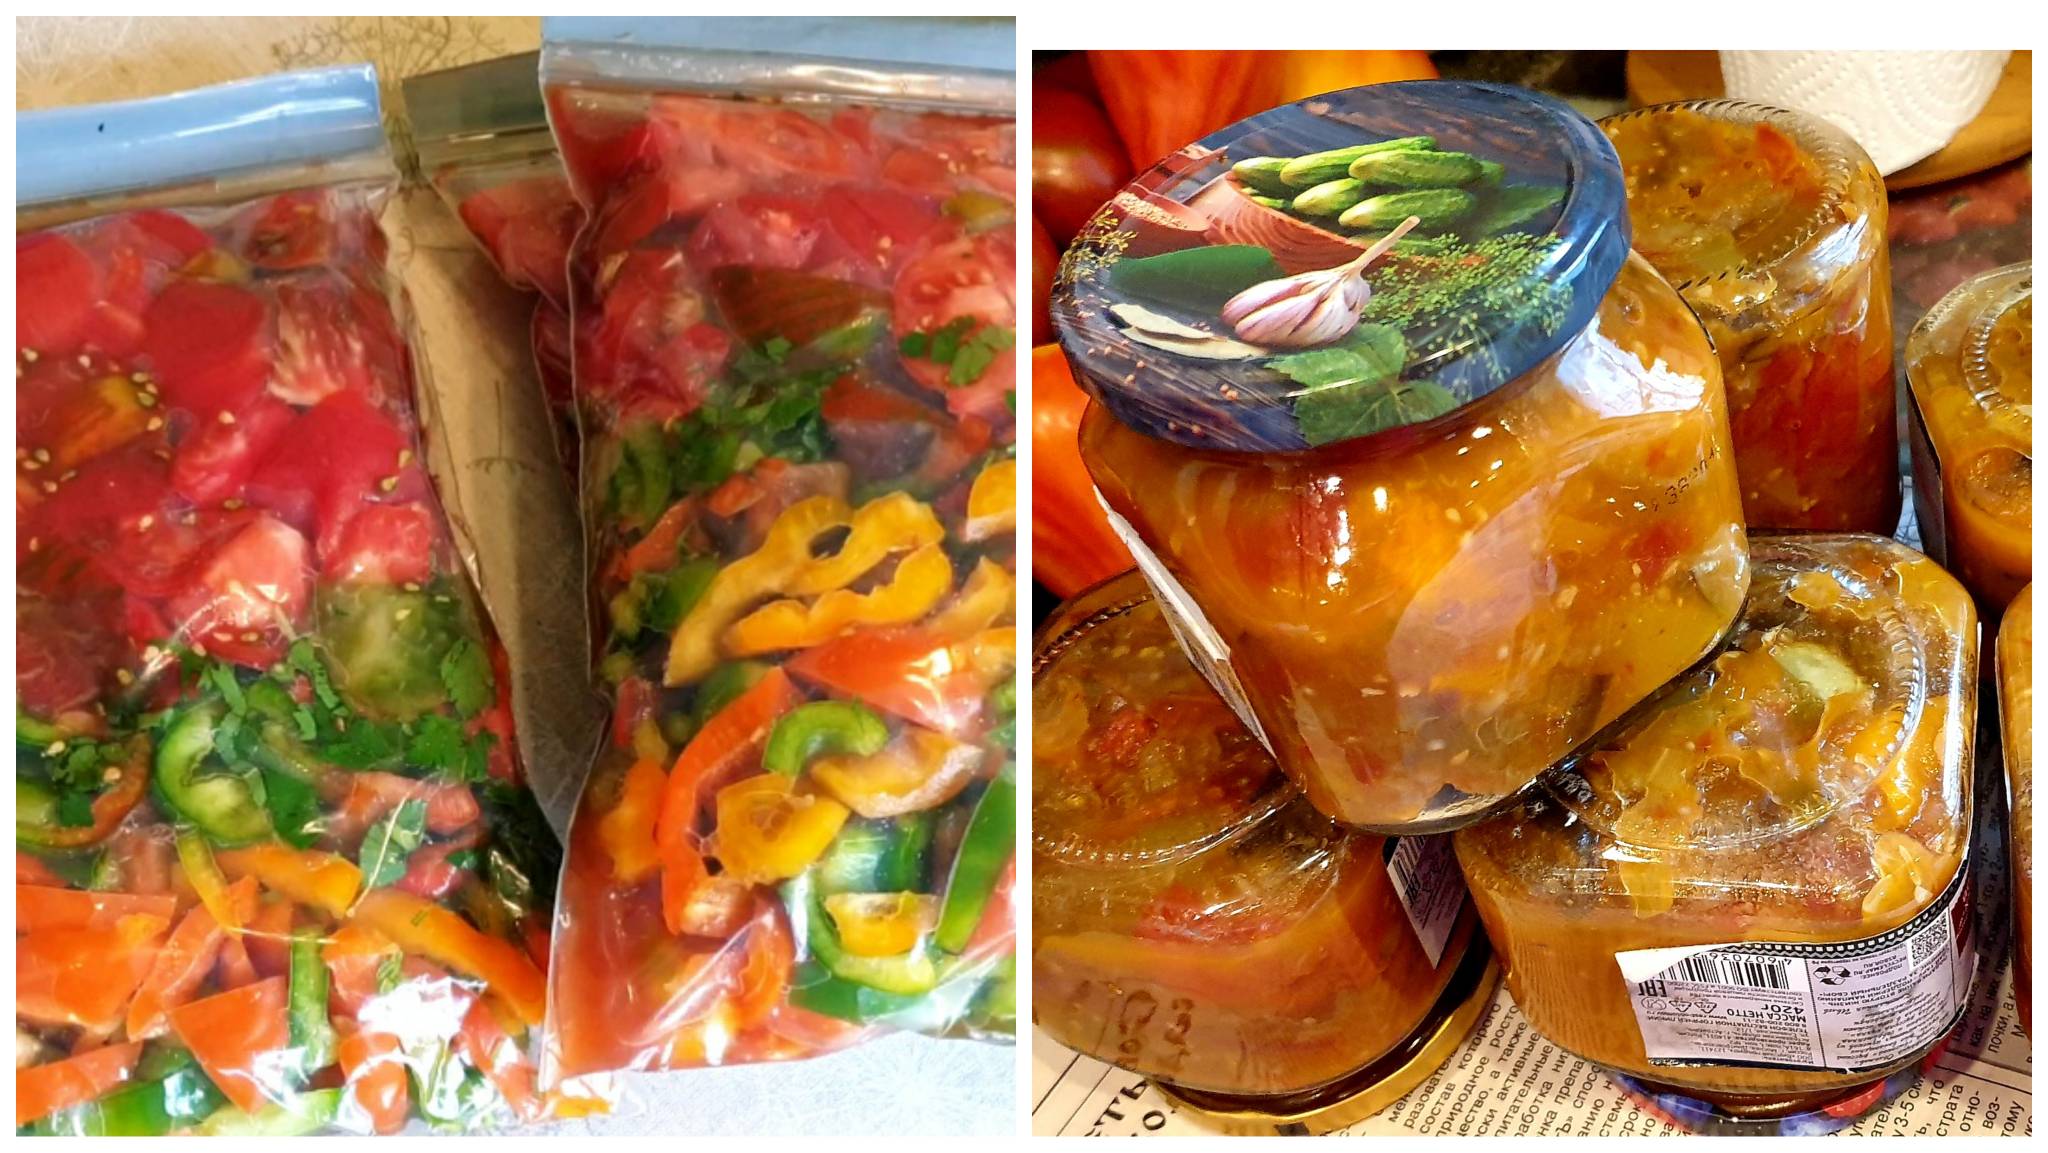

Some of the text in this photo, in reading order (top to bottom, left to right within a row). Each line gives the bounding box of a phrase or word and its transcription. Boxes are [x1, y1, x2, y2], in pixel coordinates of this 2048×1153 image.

[1860, 963, 1902, 980] ПОДРОБНЕЕ:
[1850, 976, 1907, 995] РАЗДЕЛЬНЫЙ
[1761, 1004, 1804, 1015] 420г
[1862, 994, 1895, 1004] ВТОРУЮ
[1715, 1020, 1768, 1029] БЕСПЛАТНОЙ
[1726, 1008, 1806, 1023] МАССА НЕТТО
[1988, 1014, 2012, 1053] почки,
[1490, 1071, 1500, 1079] а
[1498, 1022, 1528, 1062] также
[1420, 1003, 1501, 1134] состав которого
[1476, 1032, 1543, 1136] ски активные
[1927, 1080, 1945, 1104] что
[1894, 1101, 1914, 1127] 3-5
[1936, 1082, 1964, 1136] страта
[1960, 1090, 1980, 1131] отно-
[1983, 1097, 2000, 1128] воз-
